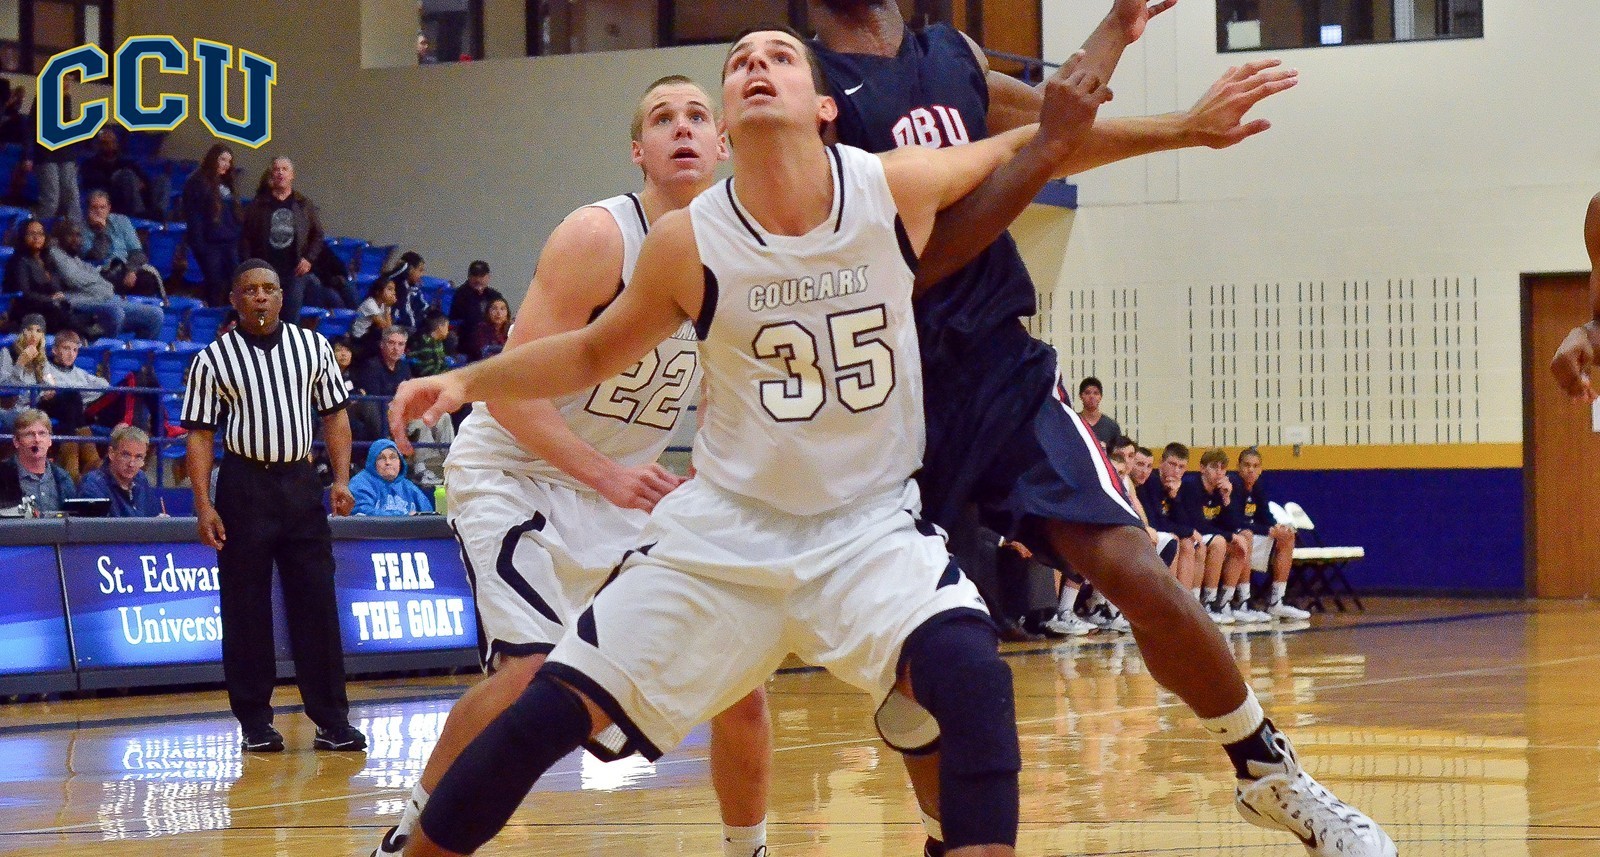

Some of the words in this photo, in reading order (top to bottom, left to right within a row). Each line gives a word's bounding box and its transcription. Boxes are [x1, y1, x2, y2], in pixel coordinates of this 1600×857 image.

[748, 264, 869, 312] COUGARS
[752, 303, 896, 423] 35
[584, 347, 697, 431] 22
[97, 555, 134, 594] St.
[371, 551, 435, 591] FEAR
[351, 600, 403, 641] THE
[406, 598, 464, 638] GOAT
